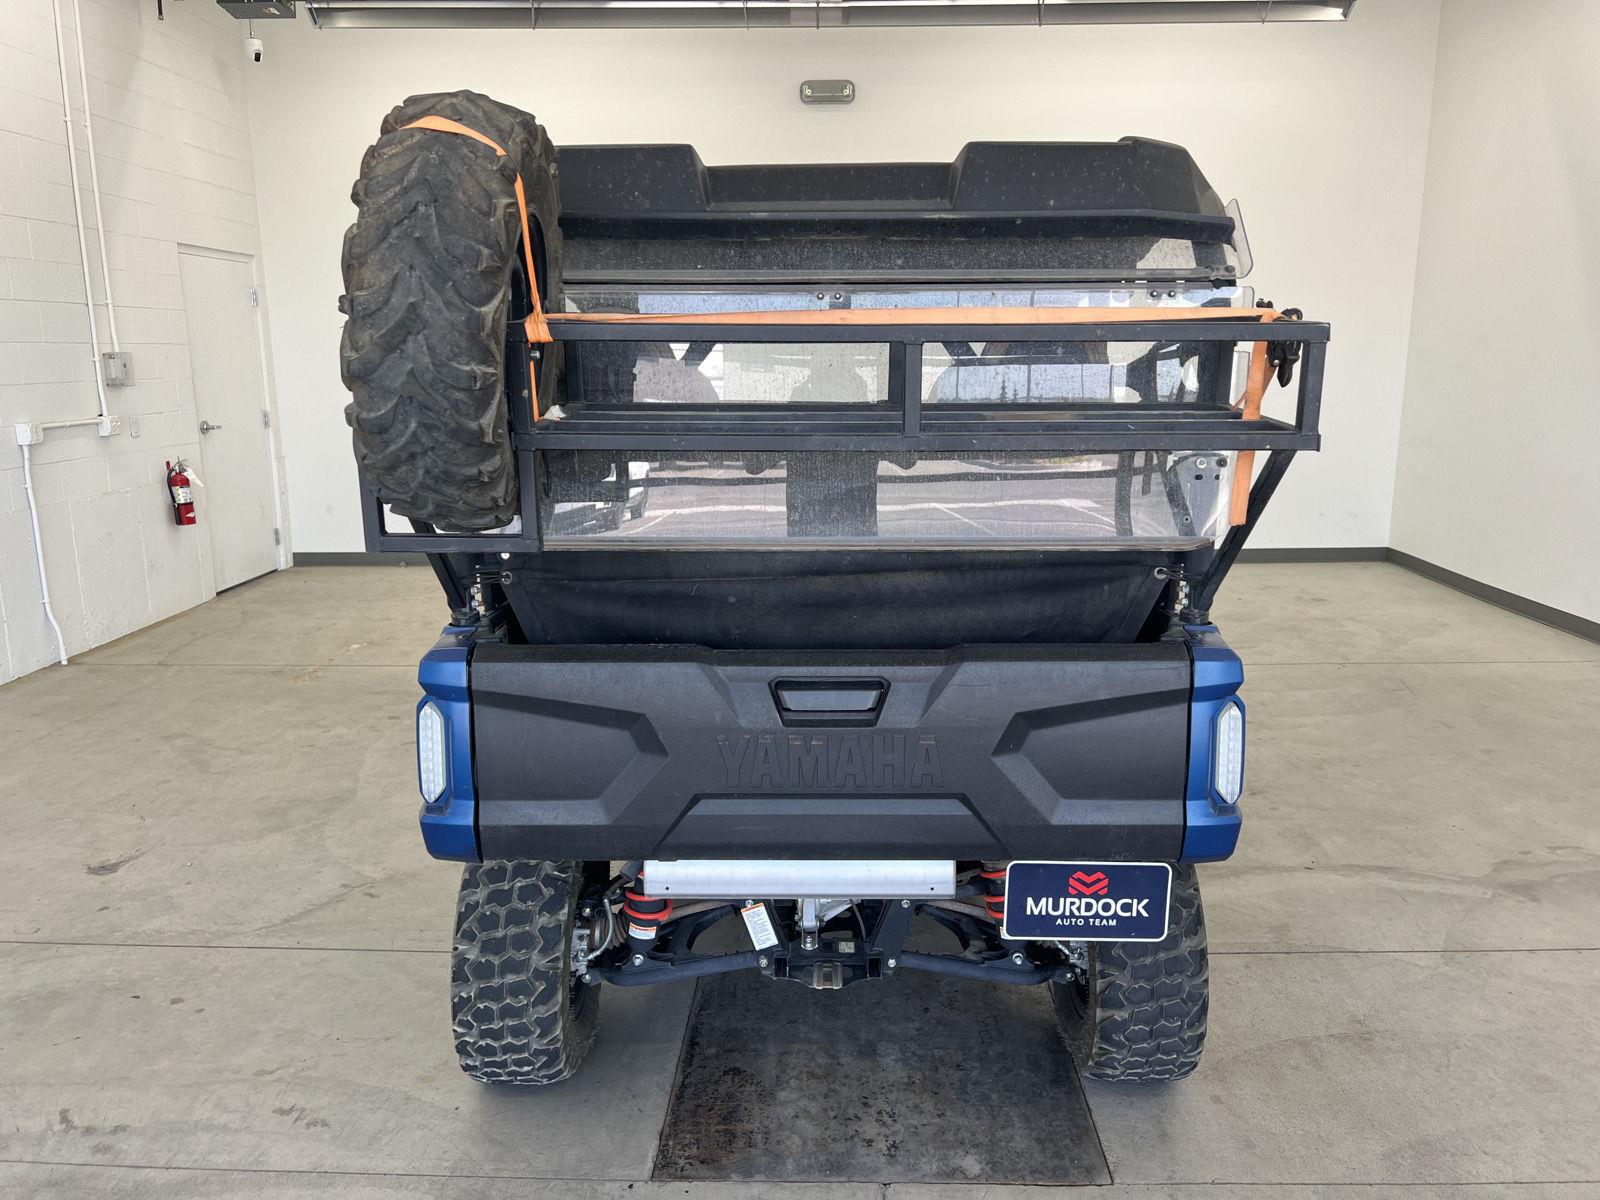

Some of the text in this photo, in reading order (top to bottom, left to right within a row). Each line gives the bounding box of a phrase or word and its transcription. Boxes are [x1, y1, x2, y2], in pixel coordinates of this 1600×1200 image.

[715, 735, 944, 788] YAMAHA
[1026, 897, 1149, 917] MURDOCK
[1056, 918, 1085, 926] AUTO
